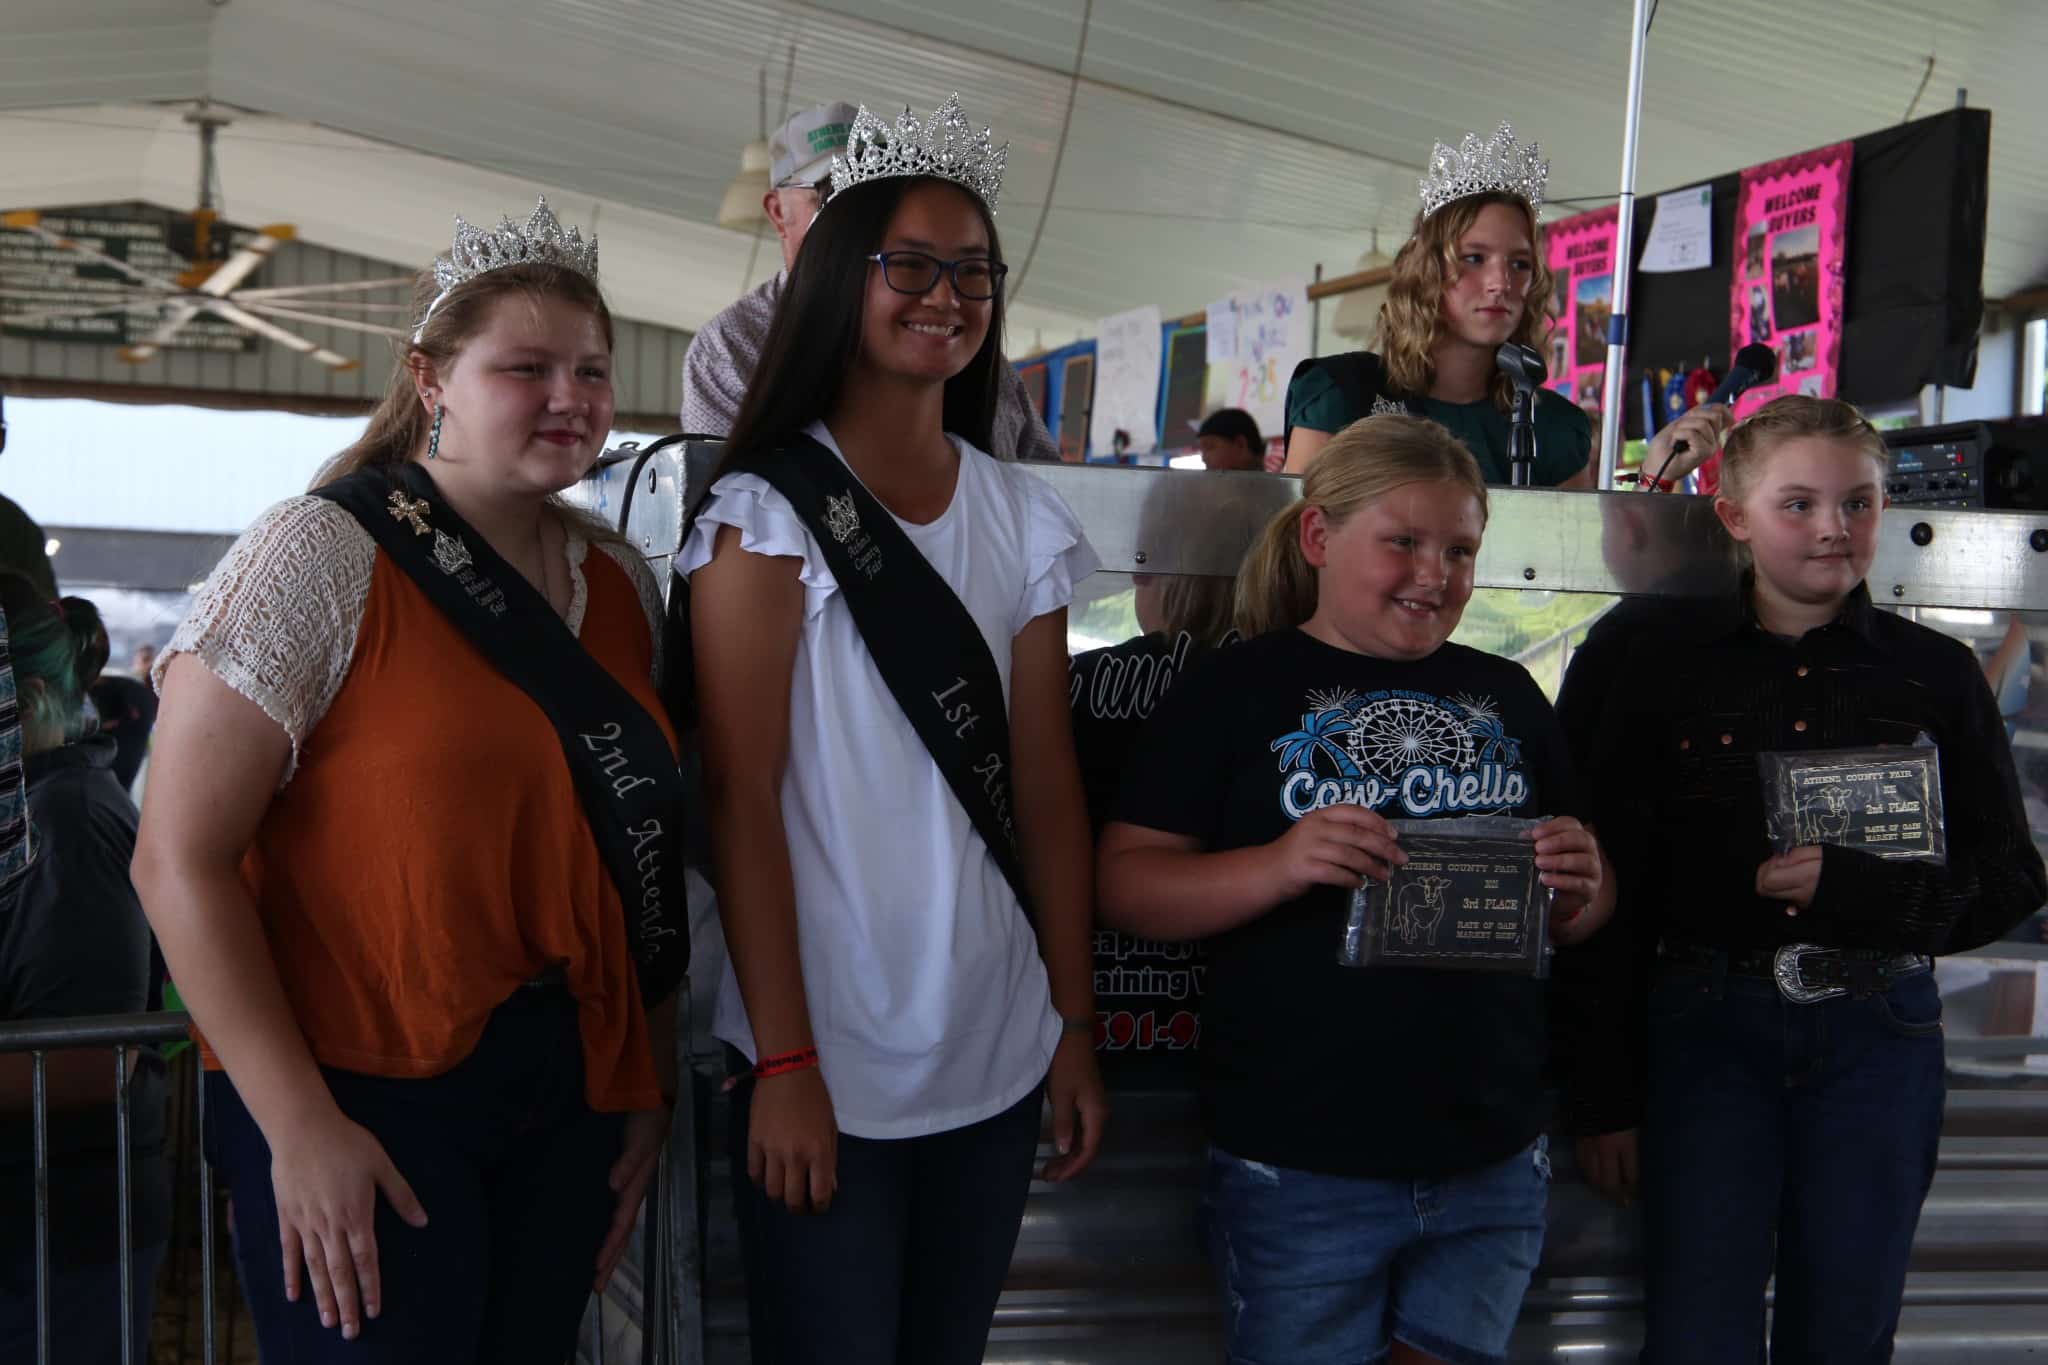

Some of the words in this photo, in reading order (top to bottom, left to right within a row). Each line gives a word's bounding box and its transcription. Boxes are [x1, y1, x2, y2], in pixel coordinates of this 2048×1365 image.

[1764, 184, 1821, 214] WELCOME
[1768, 206, 1816, 232] BUYERS
[931, 675, 981, 739] 1st
[577, 721, 656, 800] 2nd
[1803, 775, 1841, 785] ATHENS
[1846, 772, 1884, 782] COUNTY
[1889, 770, 1912, 779] FAIR
[1865, 803, 1883, 814] 2nd
[1888, 801, 1920, 813] PLACE
[1448, 862, 1488, 873] COUNTY
[1462, 898, 1479, 910] 3rd
[1484, 899, 1518, 911] PLACE
